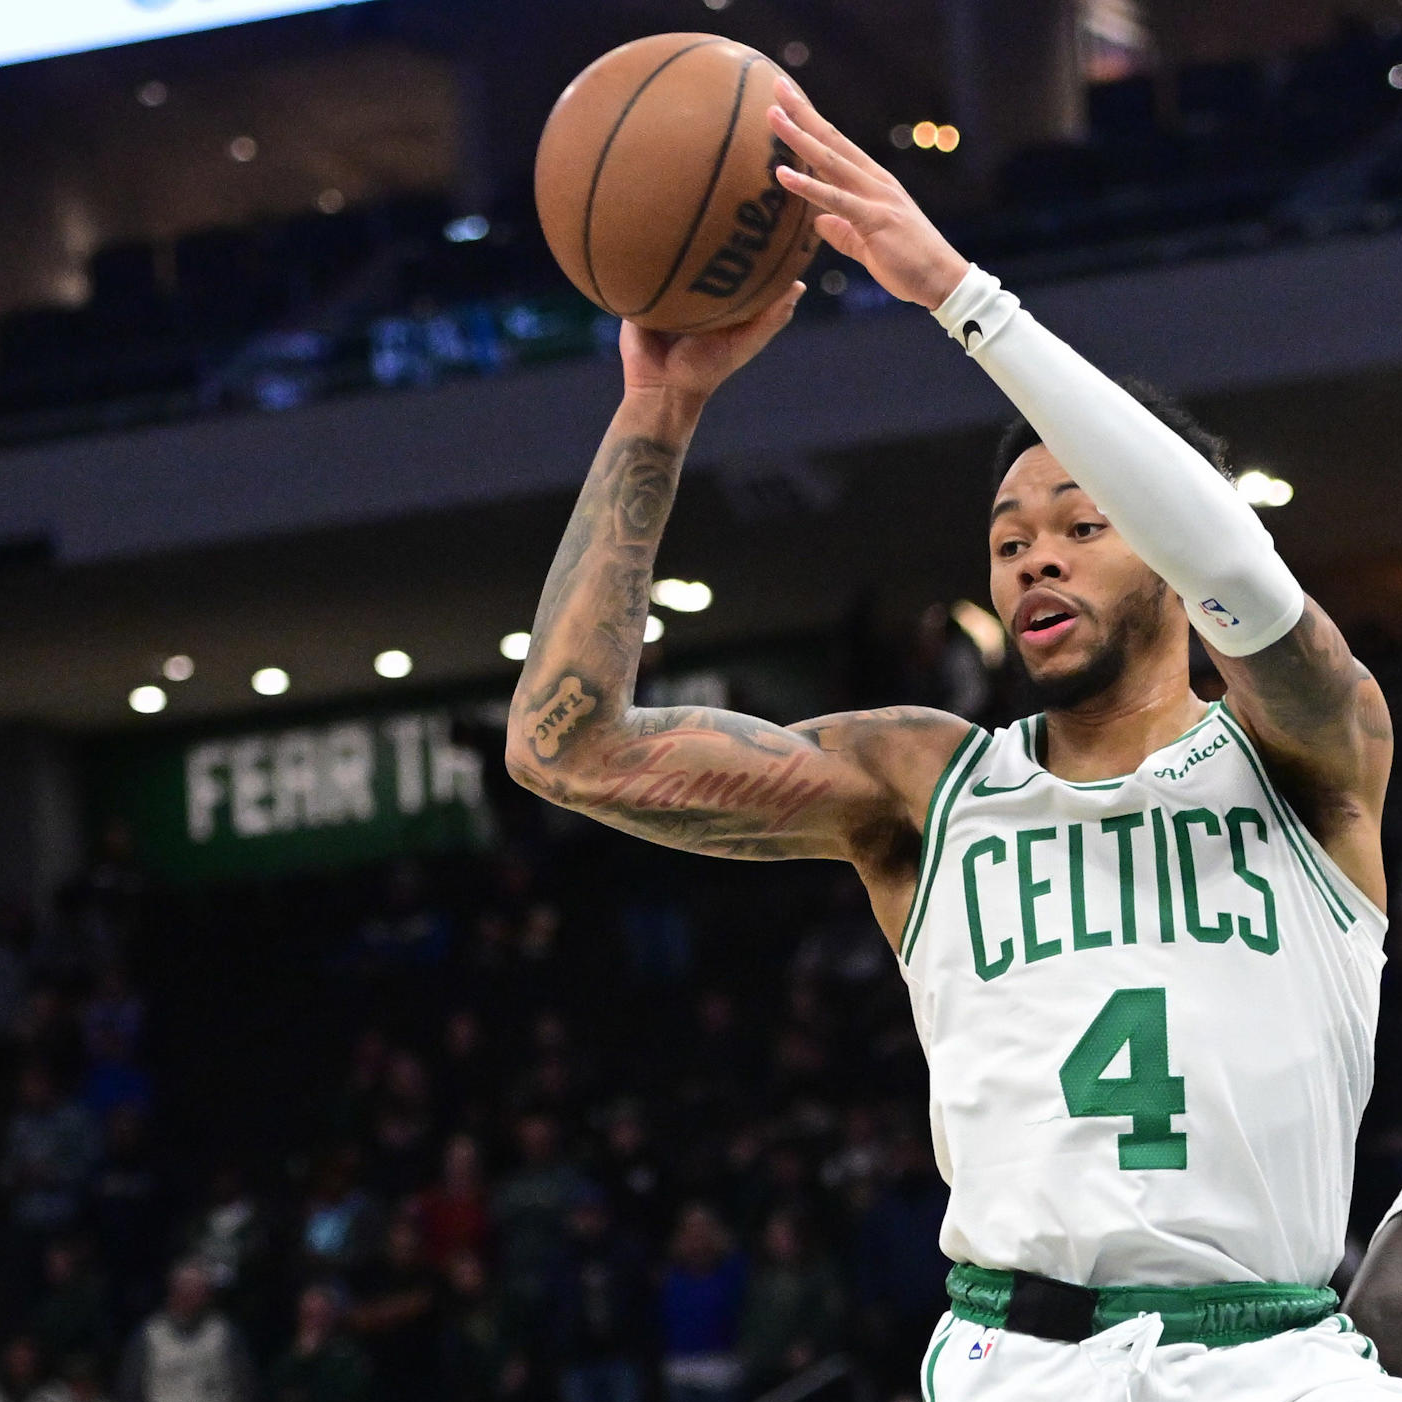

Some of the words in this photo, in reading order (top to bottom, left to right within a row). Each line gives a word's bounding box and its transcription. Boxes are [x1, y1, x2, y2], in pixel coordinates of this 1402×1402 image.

[186, 718, 374, 843] FEAR
[1153, 732, 1230, 782] Amica
[962, 806, 1281, 983] CELTICS
[1058, 986, 1188, 1172] 4
